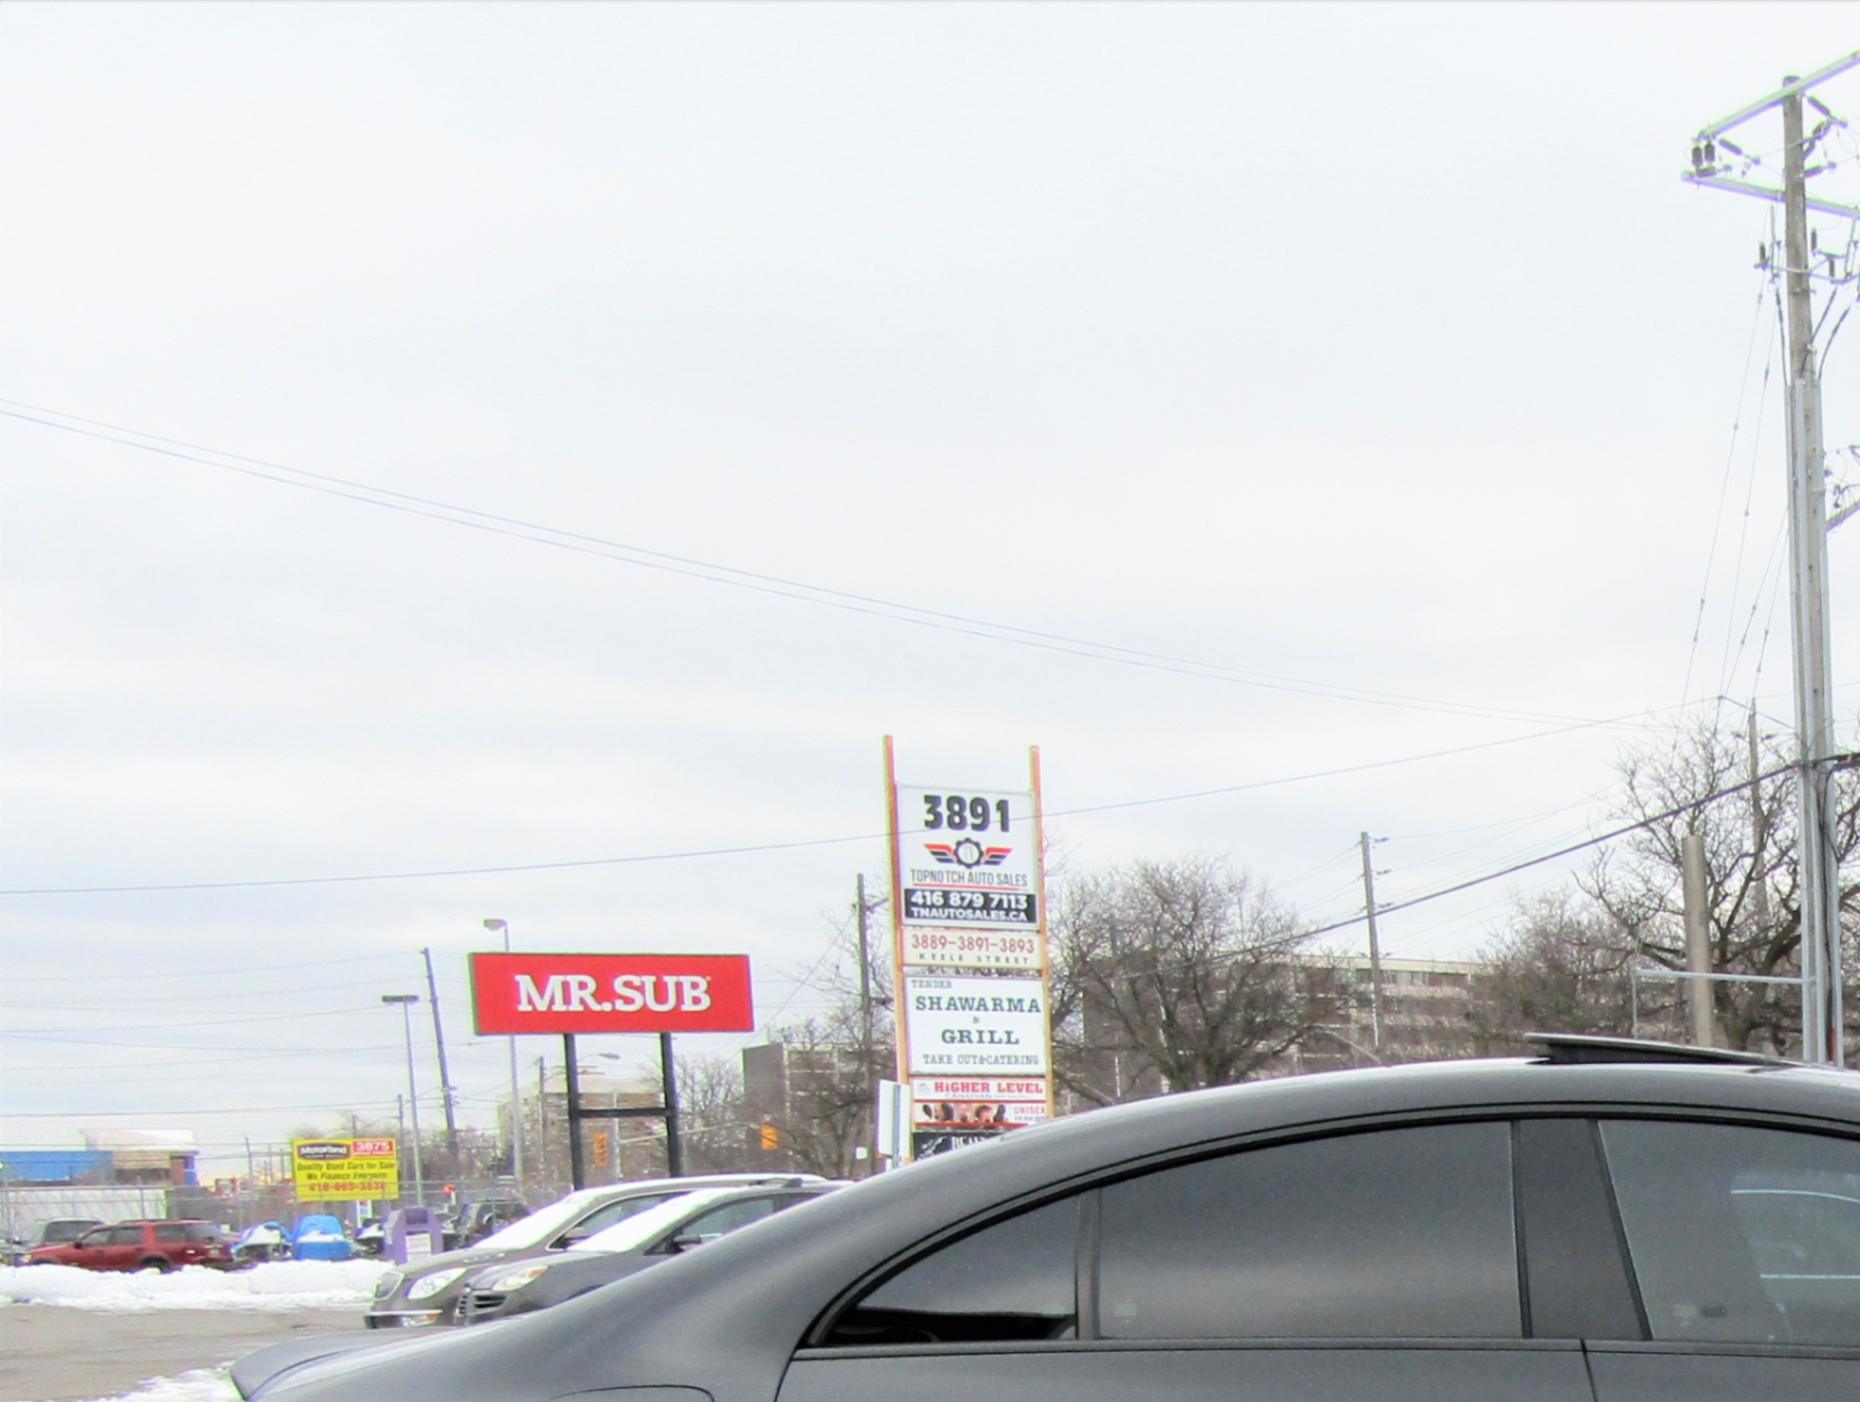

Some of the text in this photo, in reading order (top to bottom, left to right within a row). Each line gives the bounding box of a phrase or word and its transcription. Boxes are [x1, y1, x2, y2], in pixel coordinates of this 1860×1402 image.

[923, 795, 1009, 832] 3891
[967, 871, 994, 885] AUTO
[996, 873, 1028, 887] SALES
[911, 890, 1028, 910] 416 879 7113
[911, 907, 1028, 922] TNAUTOSALES.CA
[514, 974, 712, 1012] MR.SUB
[915, 996, 1042, 1013] SHAWARMA
[941, 1028, 1020, 1045] GRILL
[923, 1054, 953, 1065] TAKE
[997, 1082, 1043, 1094] LEVEL
